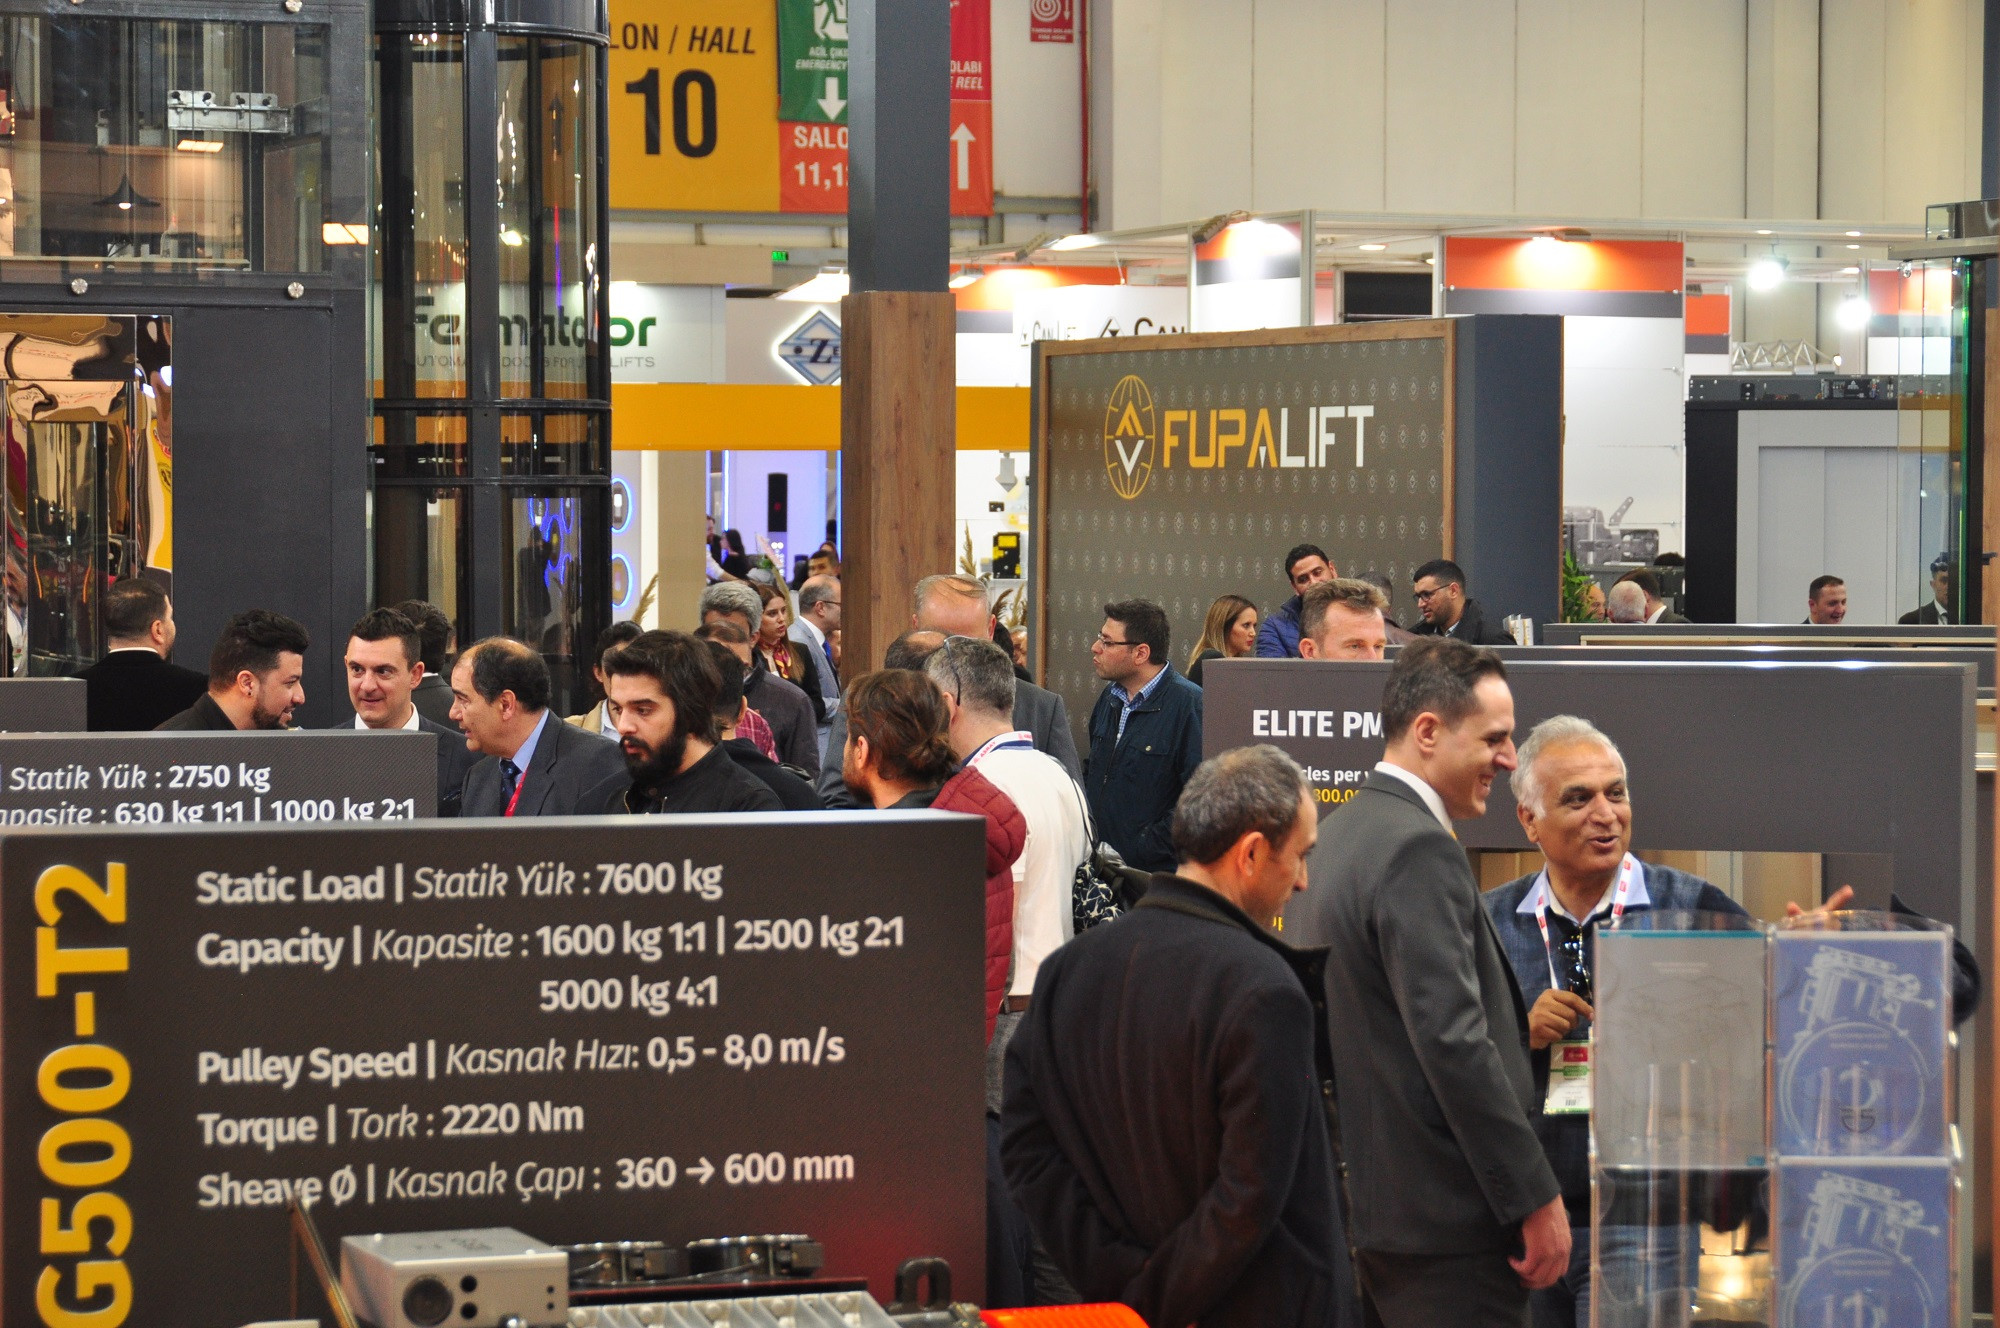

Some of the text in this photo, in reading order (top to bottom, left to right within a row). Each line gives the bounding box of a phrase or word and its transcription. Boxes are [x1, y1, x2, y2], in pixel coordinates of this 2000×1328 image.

[688, 25, 756, 55] HALL
[955, 76, 984, 91] REEL
[625, 67, 718, 159] 10
[793, 160, 849, 192] 11,1
[1162, 404, 1375, 470] FUPALIFT
[1252, 709, 1335, 738] ELITE
[8, 763, 91, 792] Statik
[98, 763, 148, 790] Yük
[168, 764, 232, 789] 2750
[238, 762, 271, 794] kg
[1333, 768, 1362, 786] per
[114, 801, 164, 824] 630
[172, 799, 205, 823] kg
[211, 800, 244, 823] 1:1
[270, 799, 335, 822] 1000
[343, 796, 375, 821] kg
[381, 797, 415, 821] 2:1
[196, 865, 296, 905] Static
[302, 865, 385, 902] Load
[412, 862, 509, 900] Statik
[516, 861, 576, 897] Yük
[596, 861, 677, 895] 7600
[683, 858, 724, 901] kg
[196, 926, 345, 974] Capacity
[371, 922, 514, 969] Kapasite
[535, 923, 616, 957] 1600
[622, 920, 663, 963] kg
[668, 921, 706, 953] 1:1
[734, 918, 814, 951] 2500
[820, 914, 860, 957] kg
[864, 916, 904, 948] 2:1
[539, 974, 718, 1017] 5000 kg 4:1
[198, 1047, 304, 1090] Pulley
[308, 1042, 418, 1088] Speed
[445, 1037, 567, 1075] Kasnak
[646, 1035, 696, 1074] 0,5
[723, 1032, 773, 1071] 8,0
[779, 1026, 846, 1066] m/s
[34, 860, 134, 1328] G500-T2
[196, 1112, 319, 1152] Torque
[346, 1103, 419, 1140] Tork
[441, 1102, 521, 1136] 2220
[528, 1100, 584, 1133] Nm
[195, 1170, 323, 1208] Sheave
[385, 1161, 508, 1199] Kasnak
[514, 1161, 585, 1203] Çapı
[615, 1156, 677, 1190] 360
[723, 1151, 787, 1185] 600
[793, 1154, 855, 1182] mm
